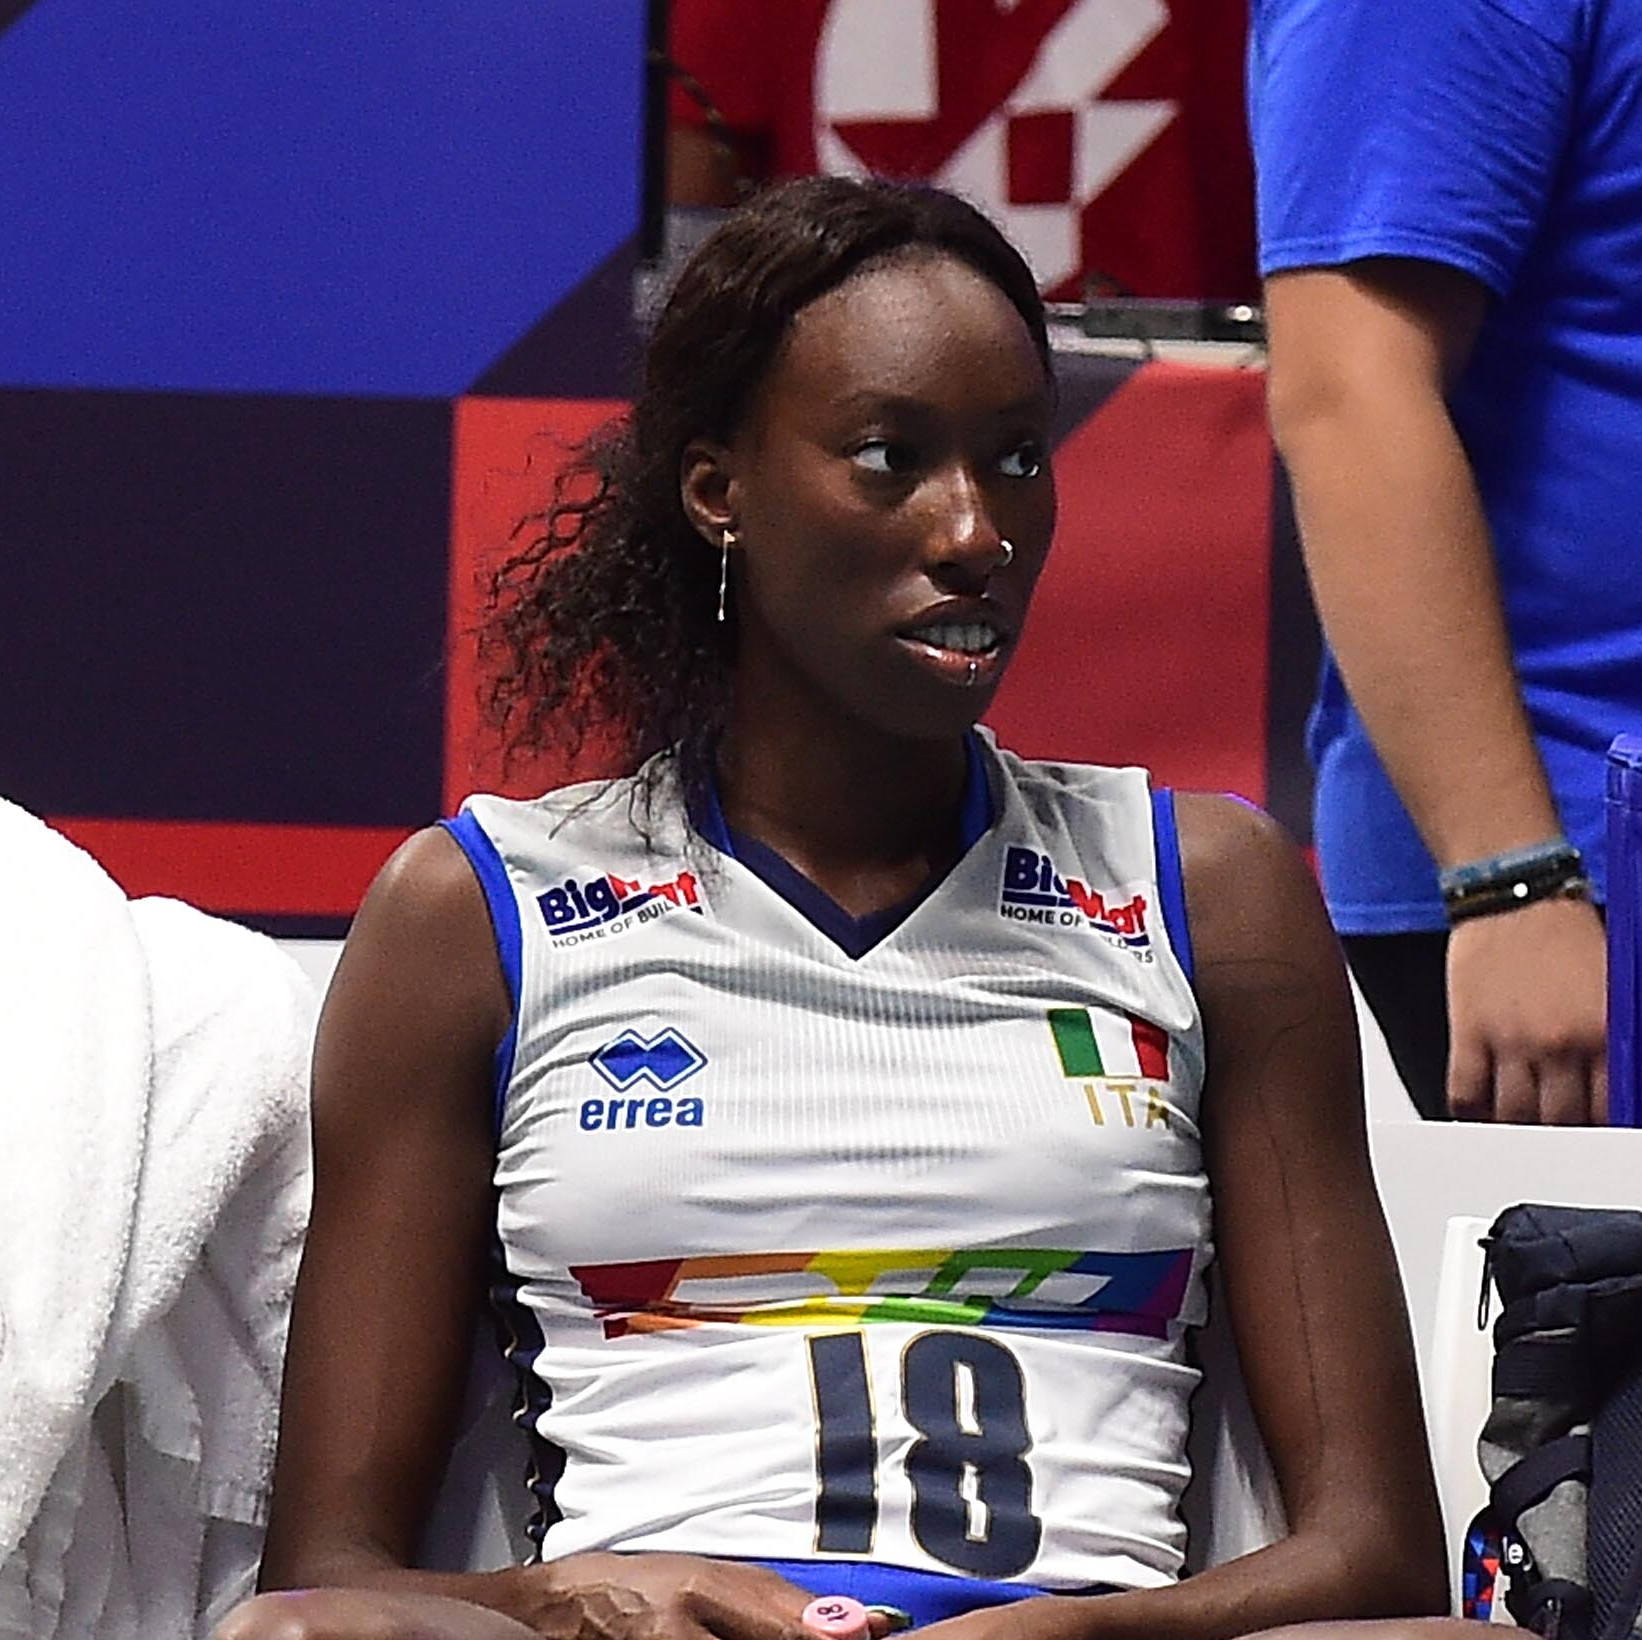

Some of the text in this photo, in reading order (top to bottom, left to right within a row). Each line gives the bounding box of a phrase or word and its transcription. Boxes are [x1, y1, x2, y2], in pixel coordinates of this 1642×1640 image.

[999, 903, 1056, 926] HOME
[551, 928, 607, 949] HOME
[610, 916, 633, 934] OF
[579, 1097, 705, 1131] errea
[1082, 1083, 1171, 1129] ITA
[803, 1328, 1044, 1581] 18
